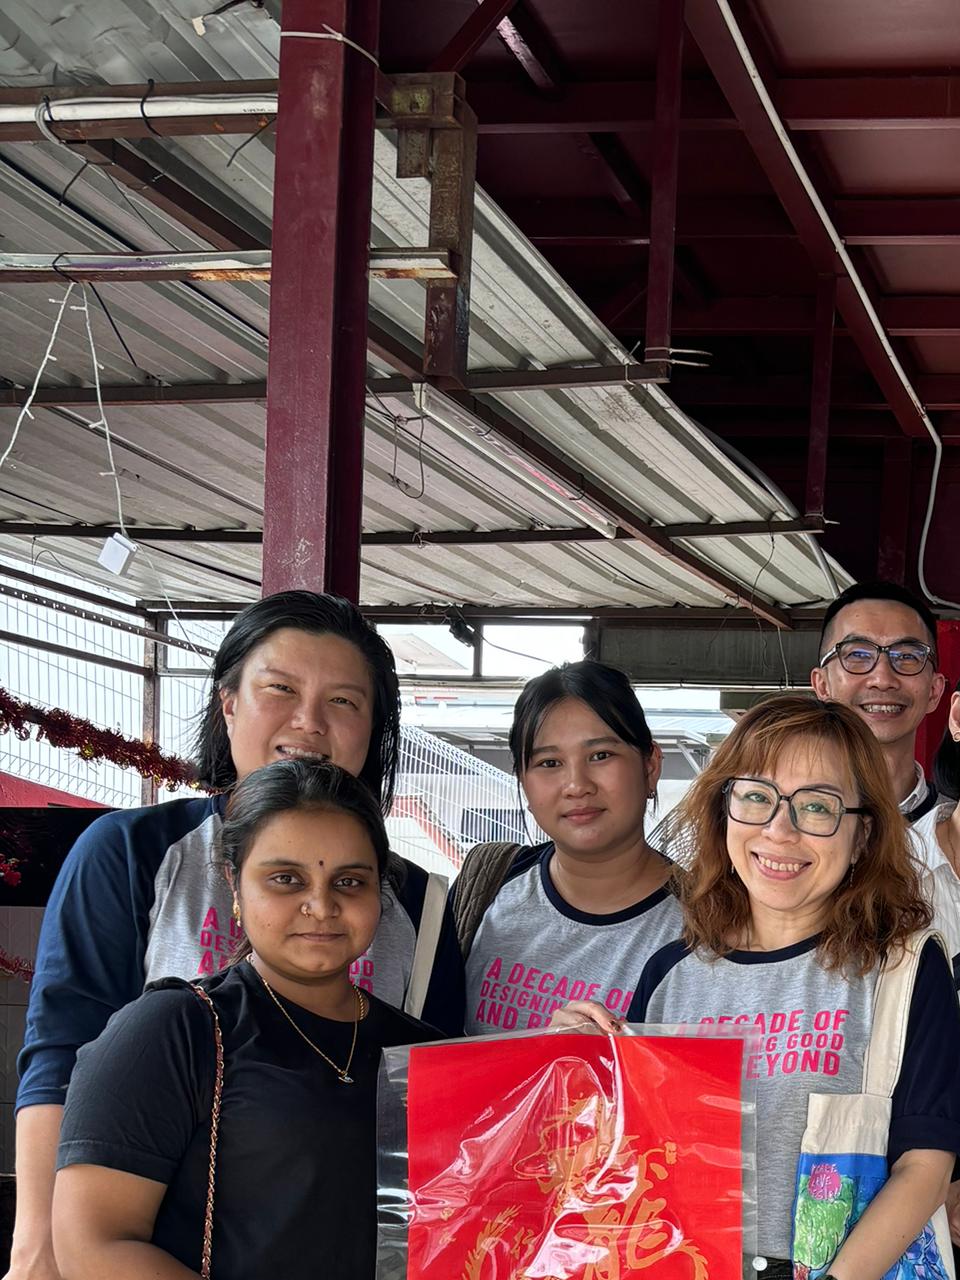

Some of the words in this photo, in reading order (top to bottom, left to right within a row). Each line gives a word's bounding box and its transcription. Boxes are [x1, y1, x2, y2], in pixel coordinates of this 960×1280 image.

[203, 907, 219, 930] A
[486, 957, 503, 980] A
[507, 963, 602, 1001] DECADE
[475, 1000, 519, 1030] AND
[813, 1009, 850, 1031] OF
[787, 1033, 844, 1051] GOOD
[746, 1050, 841, 1079] EYOND
